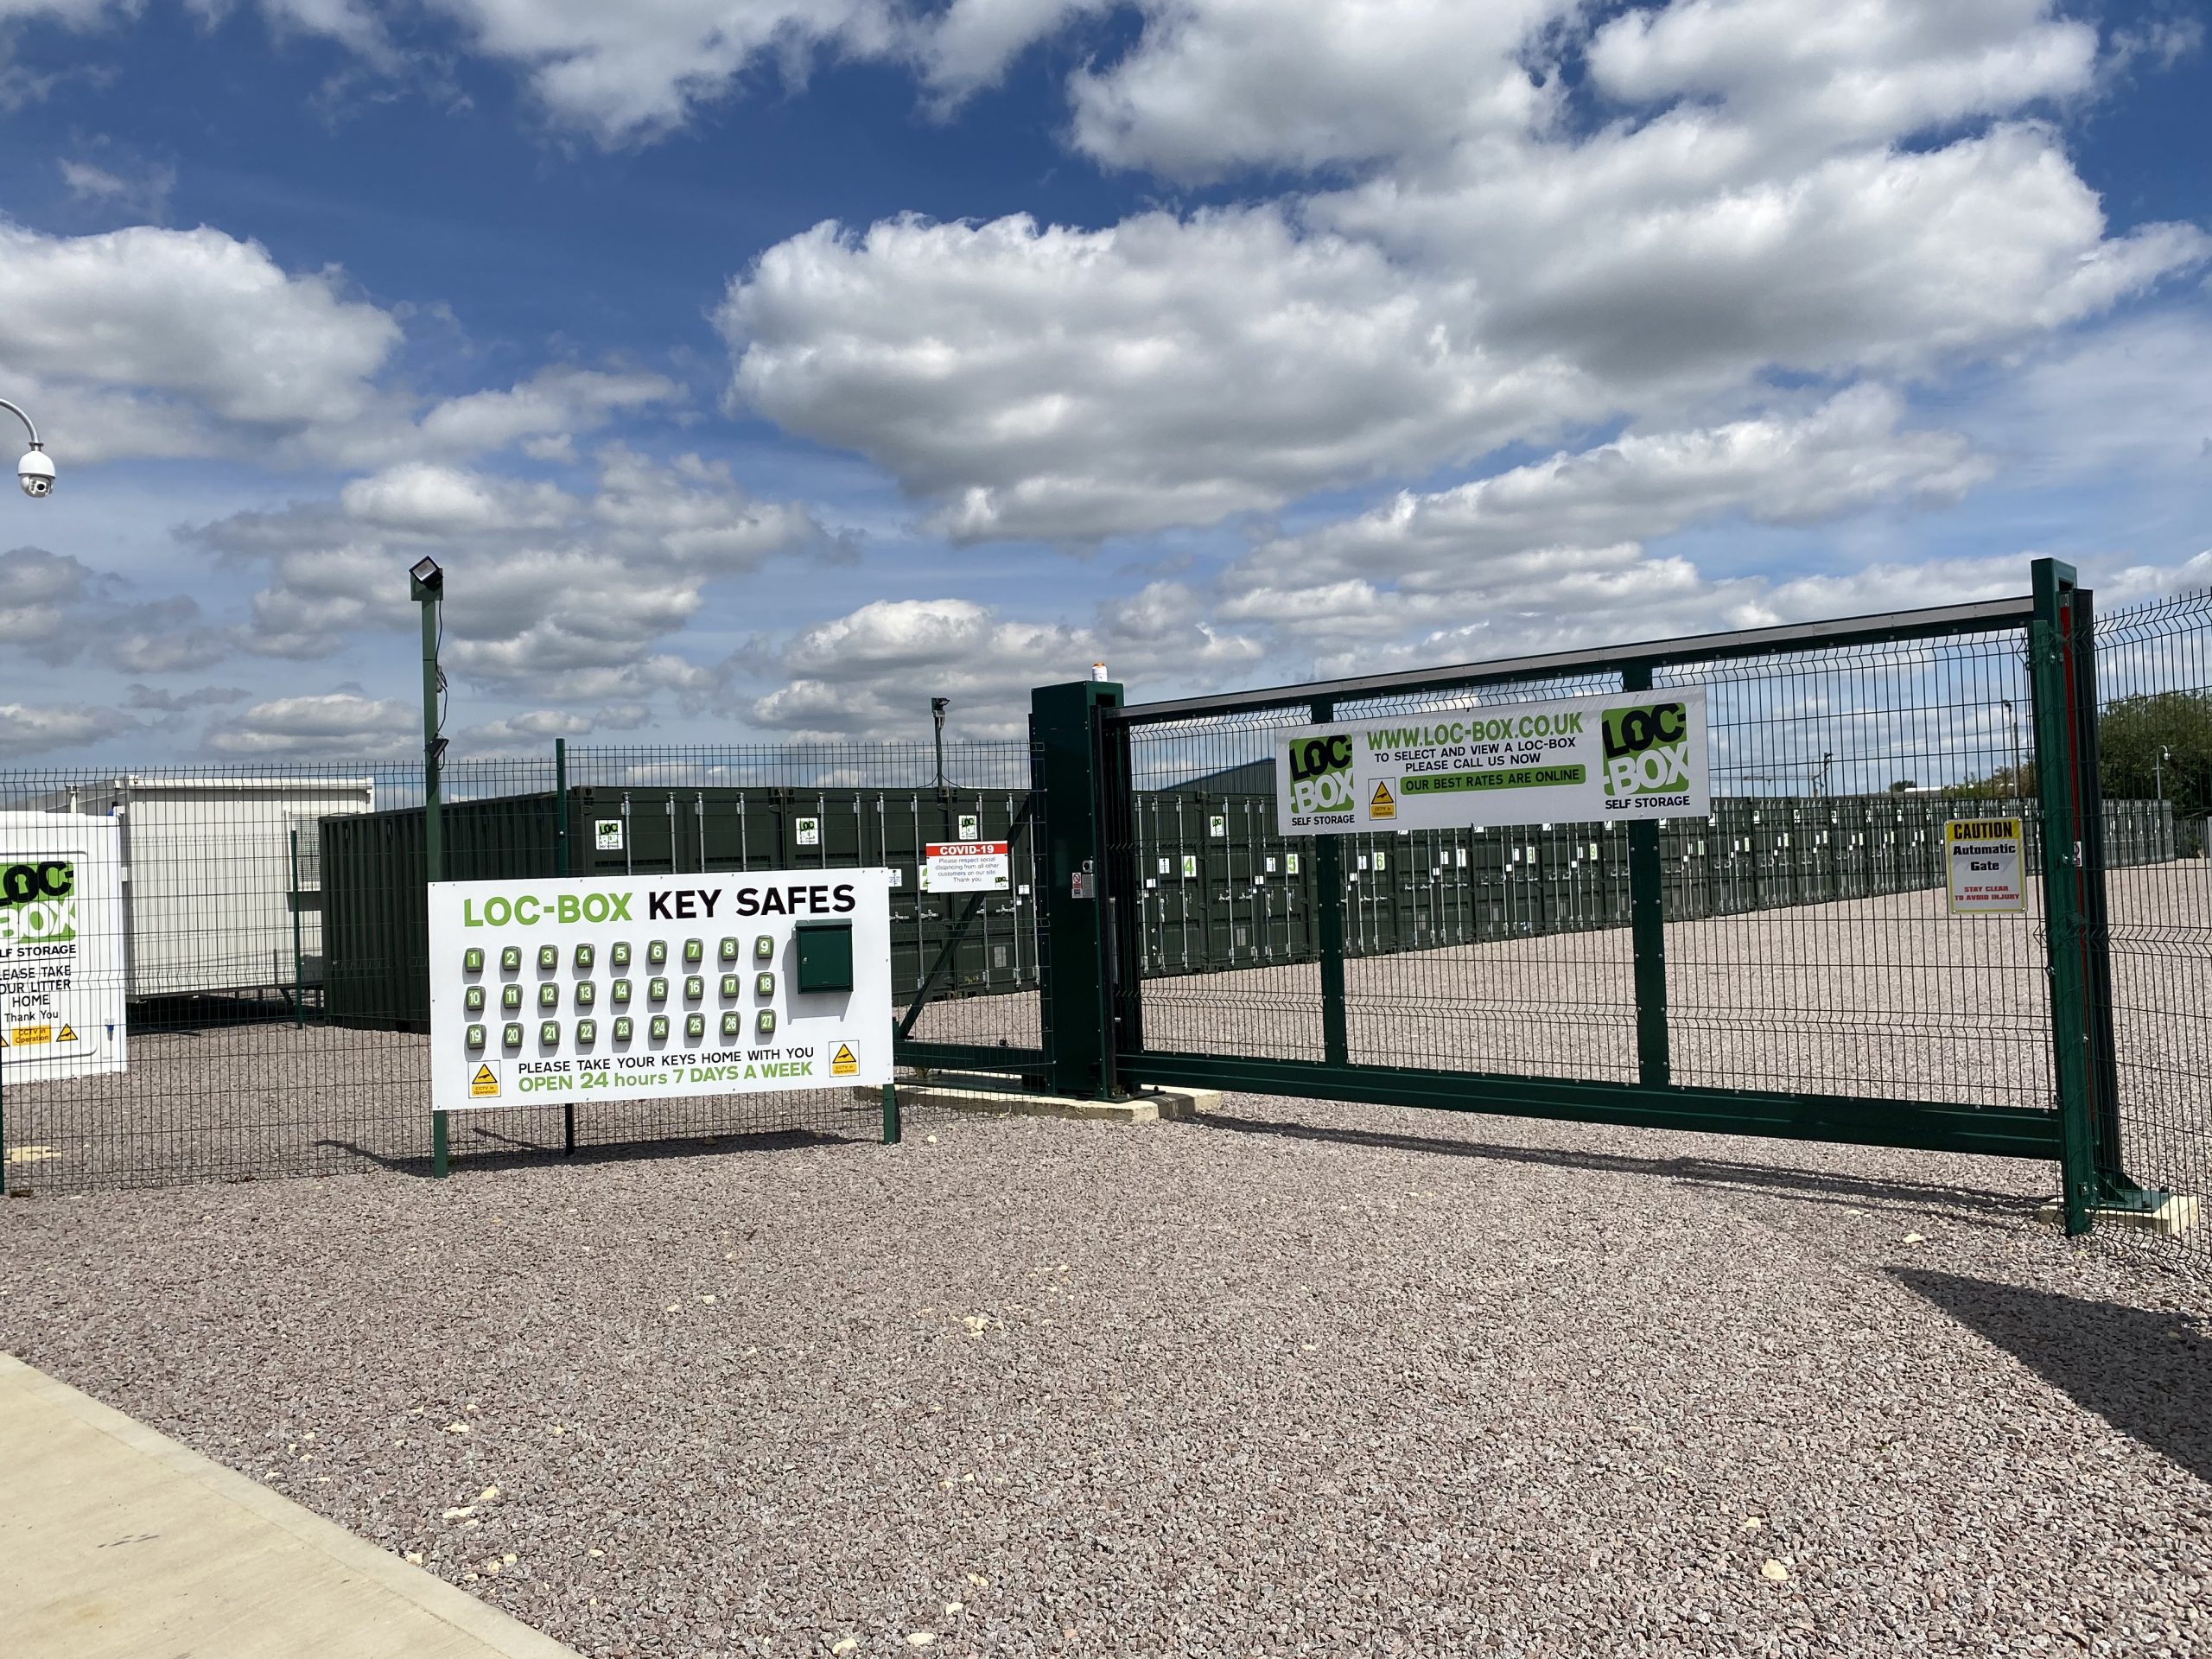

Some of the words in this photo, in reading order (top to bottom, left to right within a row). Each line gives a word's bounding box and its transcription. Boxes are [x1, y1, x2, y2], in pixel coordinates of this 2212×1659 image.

[1367, 712, 1583, 750] WWW.LOC-BOX.CO.UK
[1375, 753, 1389, 763] TO
[1394, 748, 1436, 761] SELECT
[1440, 747, 1466, 758] AND
[1471, 743, 1500, 755] VIEW
[1504, 742, 1514, 752] A
[1518, 737, 1576, 752] LOC-BOX
[1406, 760, 1449, 772] PLEASE
[1453, 758, 1483, 769] CALL
[1488, 755, 1505, 767] US
[1510, 753, 1541, 765] NOW
[1406, 779, 1429, 791] OUR
[1433, 777, 1461, 789] BEST
[1466, 774, 1503, 786] RATES
[1508, 772, 1531, 784] ARE
[1535, 769, 1580, 783] ONLINE
[1605, 799, 1631, 810] SELF
[1635, 796, 1690, 809] STORAGE
[1292, 817, 1312, 826] SELF
[1313, 815, 1355, 825] STORAGE
[1954, 822, 2012, 839] CAUTION
[940, 845, 994, 855] COVID-19
[1954, 844, 2016, 855] Automatic
[1185, 858, 1193, 872] 4
[1288, 856, 1296, 872] 5
[1971, 861, 1999, 871] Gate
[464, 893, 632, 926] LOC-BOX
[649, 889, 722, 920] KEY
[736, 884, 855, 917] SAFES
[17, 944, 76, 957] STORAGE
[653, 946, 662, 957] 6
[690, 944, 697, 956] 7
[725, 943, 734, 954] 8
[760, 941, 768, 952] 9
[507, 952, 515, 963] 2
[543, 950, 552, 963] 3
[581, 950, 589, 962] 4
[617, 947, 626, 959] 5
[470, 954, 476, 965] 1
[0, 968, 35, 981] EASE
[41, 965, 71, 977] TAKE
[0, 982, 24, 995] OUR
[31, 979, 71, 992] LITTER
[653, 982, 664, 995] 15
[690, 982, 700, 993] 16
[725, 980, 735, 991] 17
[760, 978, 772, 990] 18
[506, 990, 517, 1002] 11
[543, 988, 554, 1000] 12
[580, 987, 591, 999] 13
[617, 985, 627, 996] 14
[12, 995, 50, 1007] HOME
[469, 992, 480, 1004] 10
[4, 1012, 35, 1022] Thank
[41, 1010, 59, 1020] You
[762, 1015, 772, 1027] 27
[618, 1022, 628, 1034] 23
[654, 1021, 665, 1033] 24
[691, 1019, 701, 1031] 25
[726, 1018, 736, 1029] 26
[470, 1030, 480, 1041] 19
[507, 1029, 518, 1041] 20
[545, 1027, 556, 1039] 21
[582, 1026, 592, 1038] 22
[518, 1061, 570, 1074] PLEASE
[577, 1058, 611, 1071] TAKE
[617, 1056, 655, 1069] YOUR
[662, 1054, 696, 1066] KEYS
[702, 1052, 741, 1064] HOME
[747, 1049, 780, 1061] WITH
[786, 1047, 814, 1058] YOU
[518, 1075, 573, 1092] OPEN
[581, 1071, 608, 1089] 24
[614, 1072, 668, 1087] hours
[673, 1069, 684, 1084] 7
[690, 1065, 738, 1082] DAYS
[744, 1065, 756, 1079] A
[760, 1061, 813, 1077] WEEK
